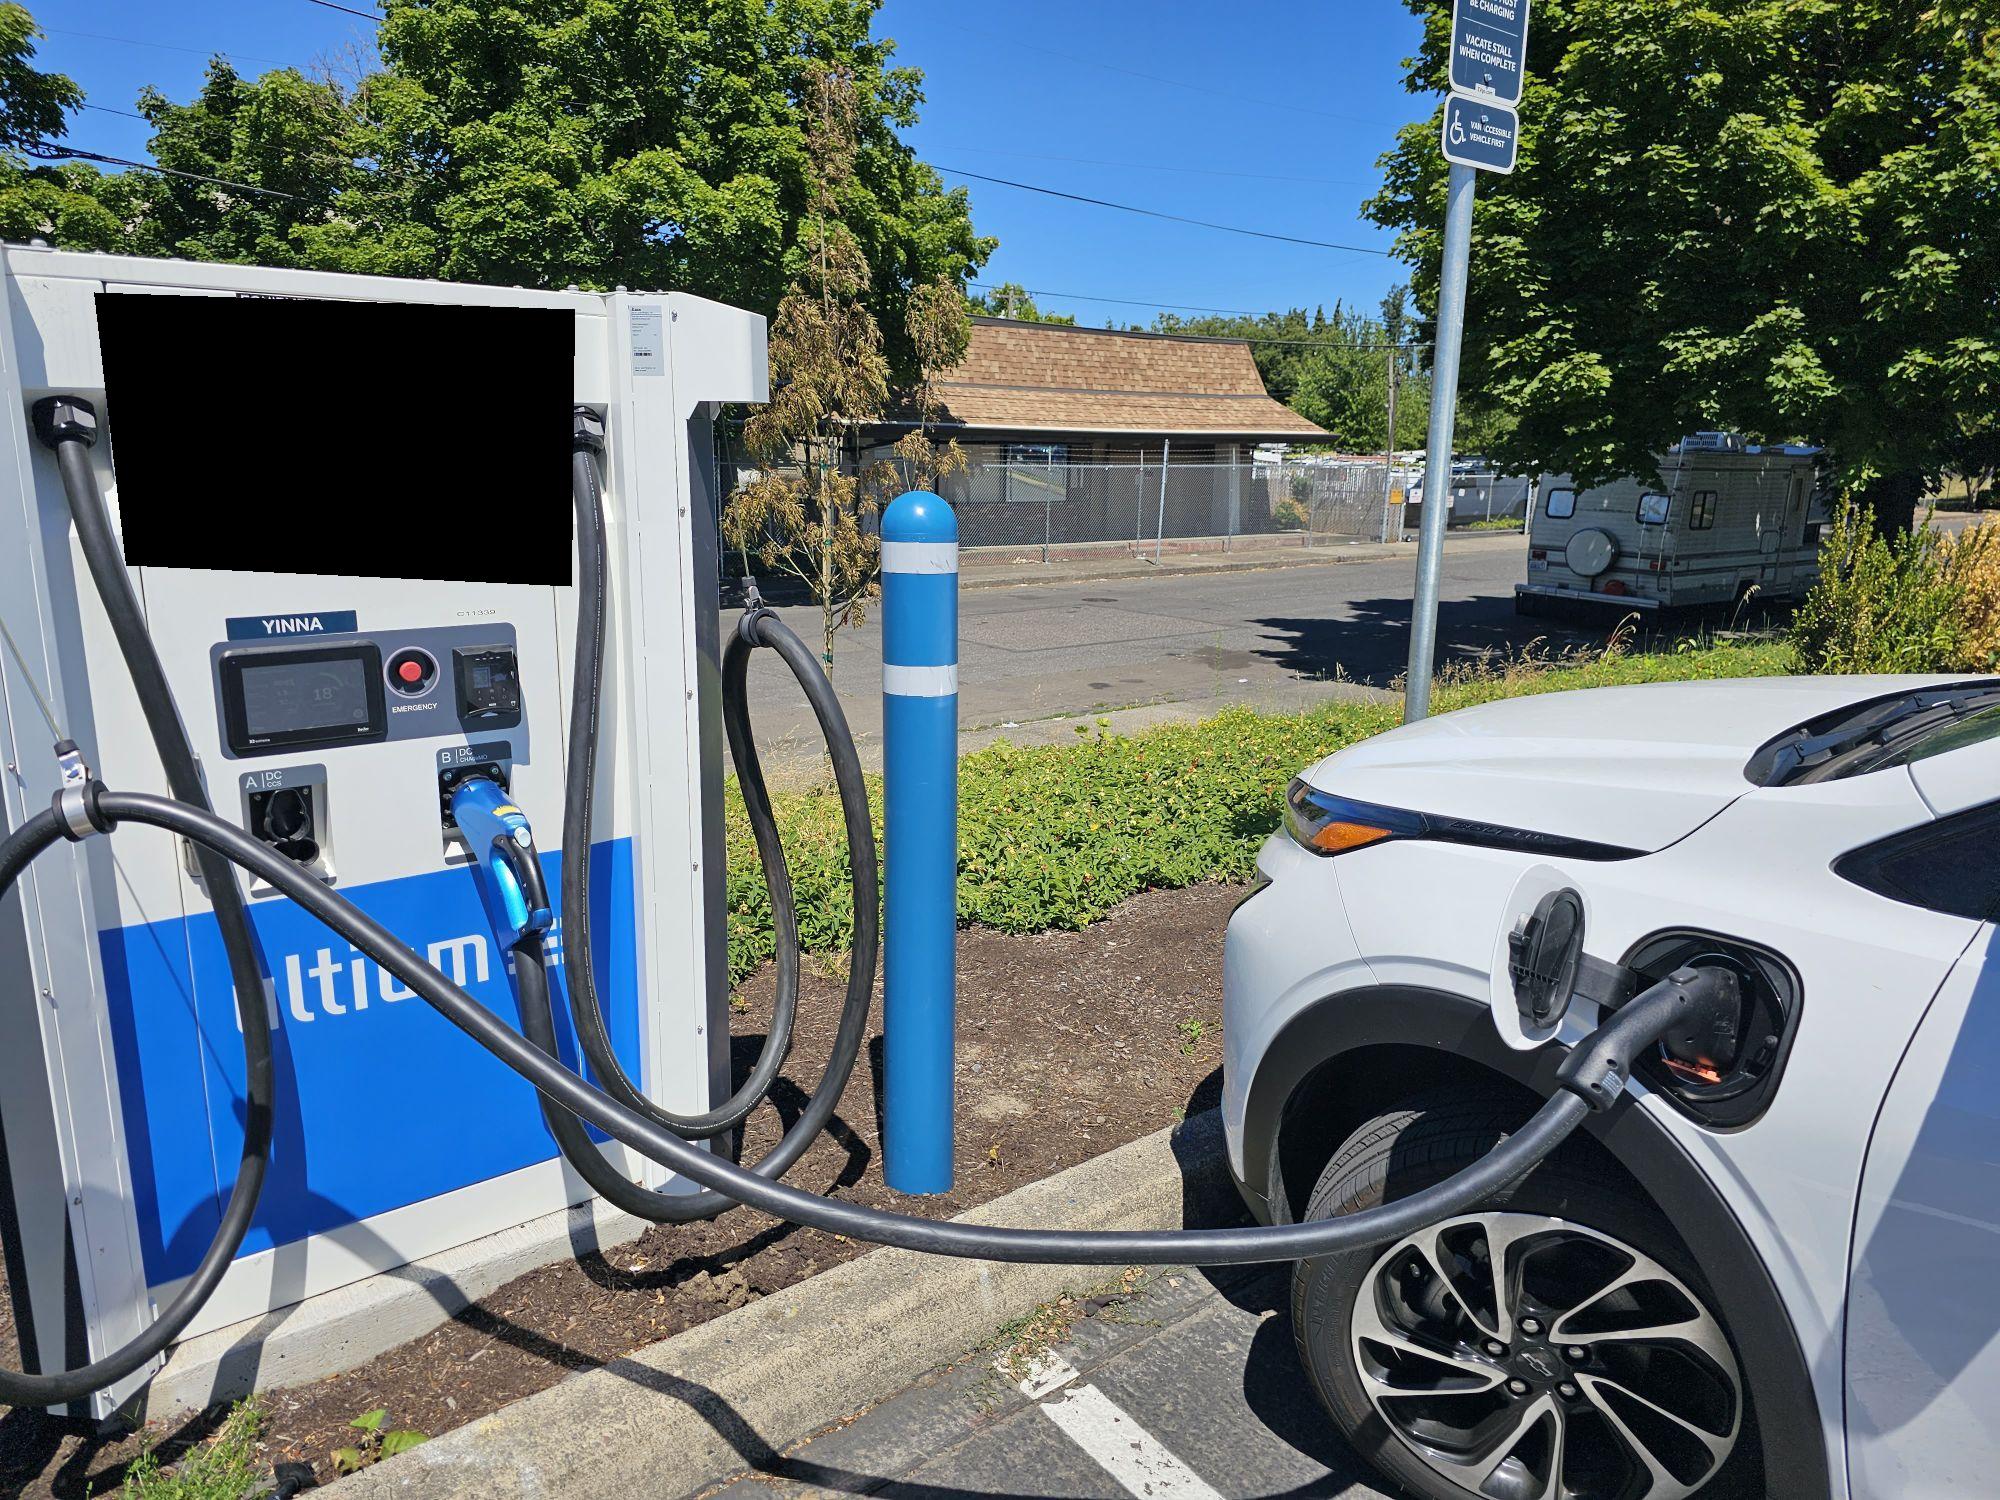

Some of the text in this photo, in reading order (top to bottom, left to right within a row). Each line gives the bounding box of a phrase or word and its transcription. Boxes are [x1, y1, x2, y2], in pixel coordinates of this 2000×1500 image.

[1469, 0, 1515, 21] BE CHARGING
[1465, 33, 1513, 58] VACATE STALL
[1459, 45, 1517, 72] WHEN COMPLETE
[1470, 121, 1512, 139] VAN ACCESSIBLE
[1469, 132, 1505, 148] VEHICLE FIRST
[262, 616, 324, 634] YINNA
[391, 702, 438, 713] EMERGENCY
[441, 747, 473, 764] B DC
[245, 770, 282, 789] A DC
[266, 780, 282, 788] CCS
